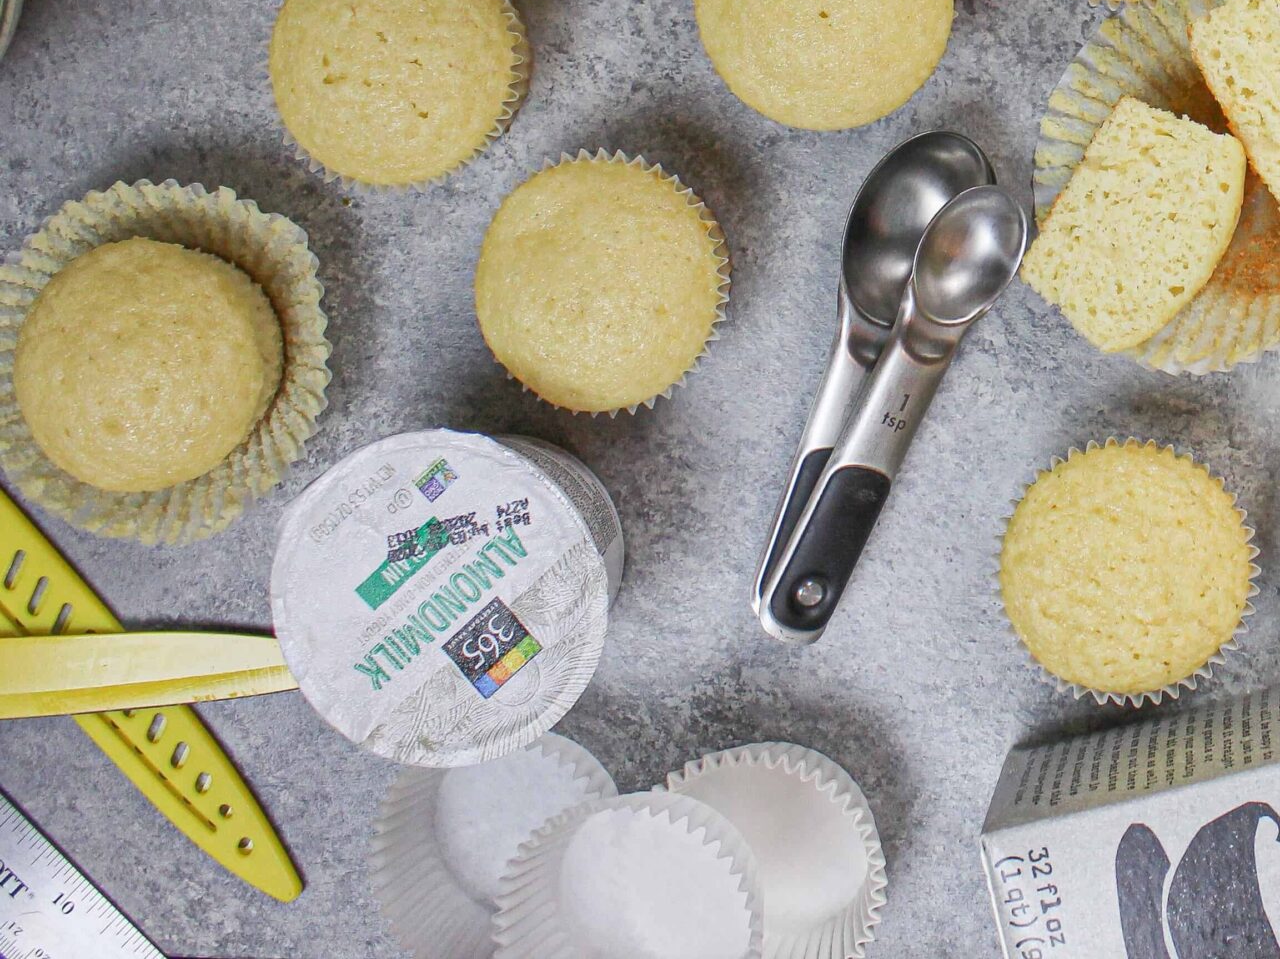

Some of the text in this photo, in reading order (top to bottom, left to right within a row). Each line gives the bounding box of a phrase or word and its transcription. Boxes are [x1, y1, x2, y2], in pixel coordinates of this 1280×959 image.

[900, 393, 911, 411] 1
[881, 411, 906, 433] tsp
[353, 525, 530, 691] ALMONDMILK
[462, 614, 516, 670] 365
[52, 892, 76, 915] 10
[1028, 847, 1066, 948] 32 fl oz
